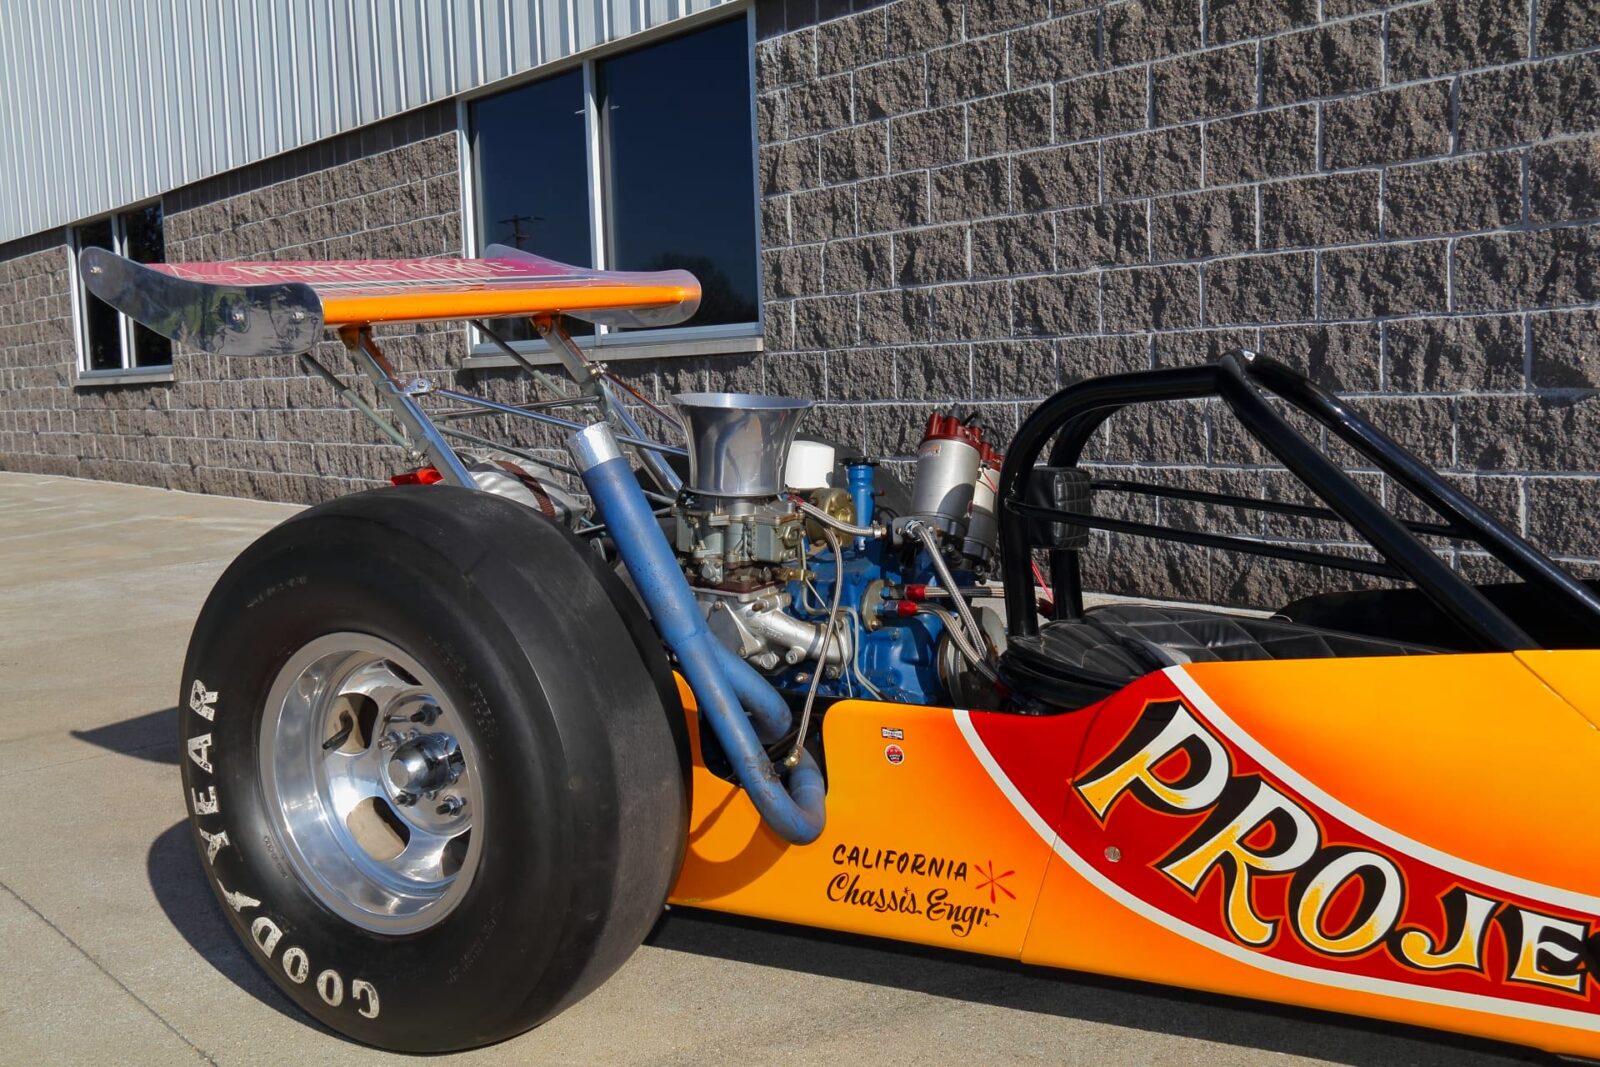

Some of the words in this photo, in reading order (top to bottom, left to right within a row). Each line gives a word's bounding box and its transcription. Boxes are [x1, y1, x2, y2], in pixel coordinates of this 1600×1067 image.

[229, 264, 414, 278] PERFECT
[832, 843, 968, 882] CALIFORNIA
[1076, 701, 1600, 994] PROJE
[826, 872, 922, 914] Chassis
